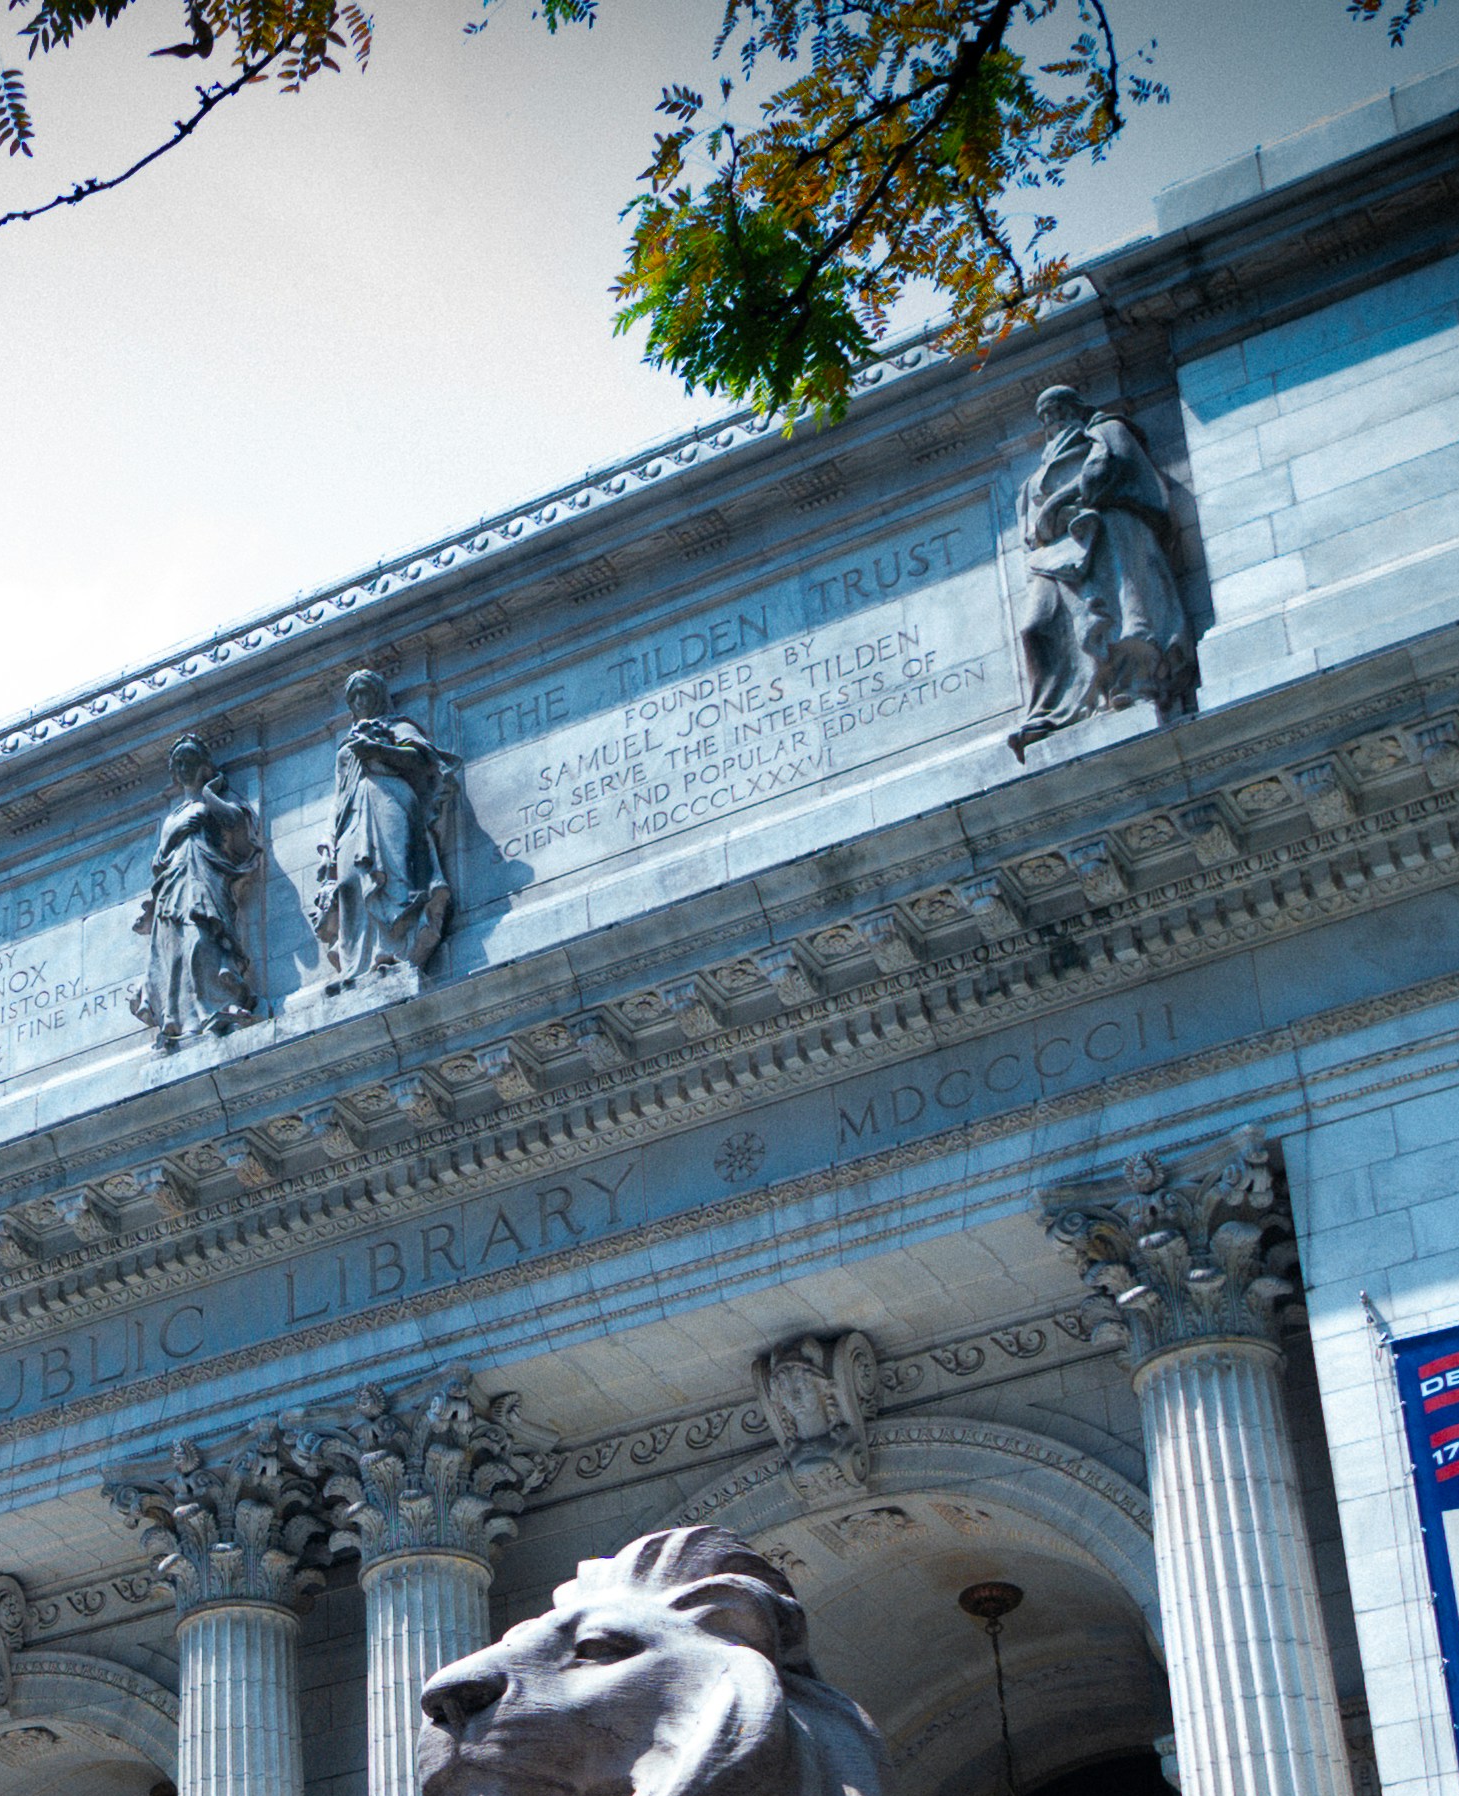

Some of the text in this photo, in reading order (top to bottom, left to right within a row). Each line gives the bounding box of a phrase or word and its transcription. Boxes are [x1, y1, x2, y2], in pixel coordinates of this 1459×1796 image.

[486, 528, 961, 745] THE TILDEN TRUST
[538, 624, 919, 791] SAMUEL JONES TILDEN
[625, 638, 814, 728] FOUNDED BY
[489, 662, 986, 865] SCIENCE AND POPULAR EDUCATION
[518, 649, 937, 824] TO SERVE THE INTERESTS OF
[631, 747, 834, 839] MDCCCLXXXVI
[17, 1009, 66, 1042] FINE
[284, 1160, 640, 1327] LIBRARY
[838, 1003, 1177, 1144] MDCCCCII
